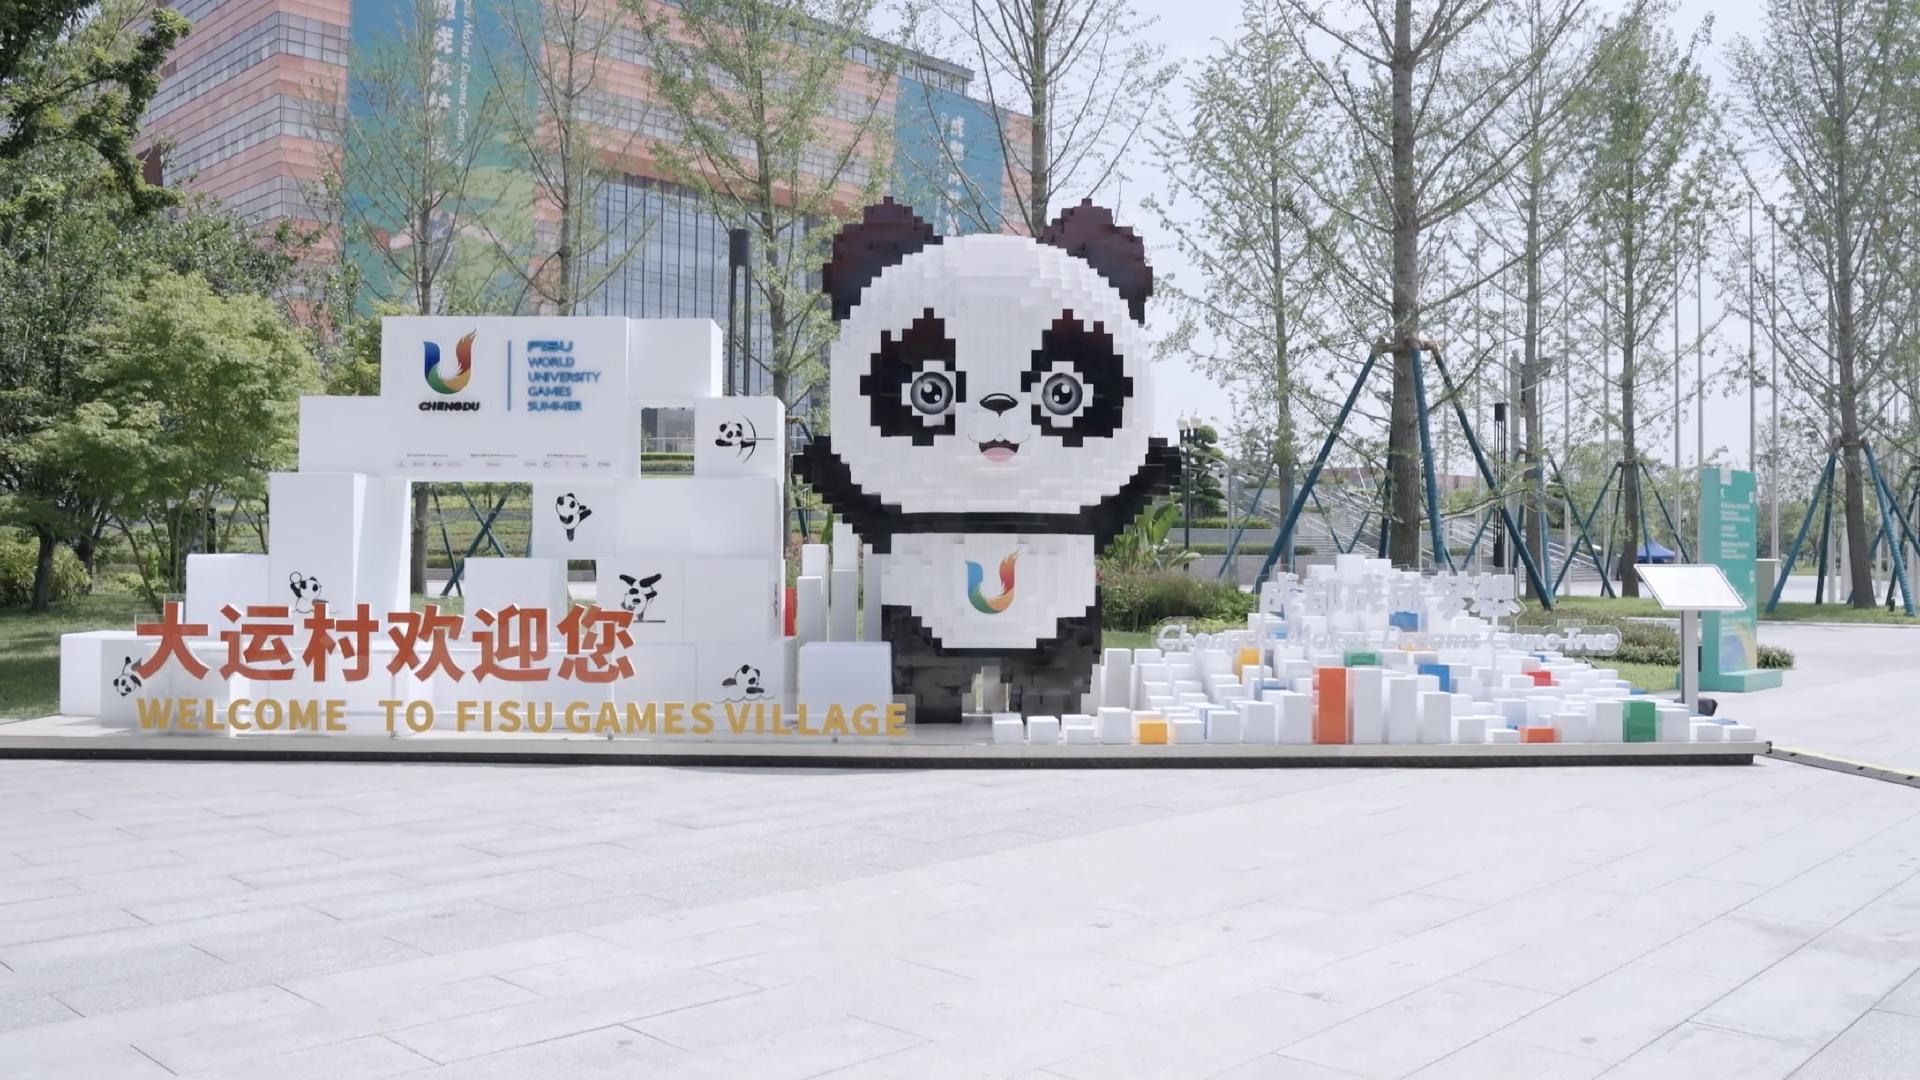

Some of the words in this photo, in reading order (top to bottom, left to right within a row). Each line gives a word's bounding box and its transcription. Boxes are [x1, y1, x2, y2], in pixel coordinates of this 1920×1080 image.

[527, 340, 574, 353] FISU
[527, 357, 575, 368] WORLD
[527, 372, 601, 384] UNIVERSITY
[527, 386, 572, 397] GAMES
[418, 401, 481, 412] CHENGDU
[527, 401, 583, 412] SUMMER
[136, 601, 635, 683] 大运村欢迎您
[1563, 627, 1618, 650] True
[137, 698, 347, 731] WELCOME
[378, 699, 435, 733] TO
[456, 700, 553, 733] FISU
[564, 701, 715, 735] GAMES
[724, 703, 908, 737] VILLAGE
